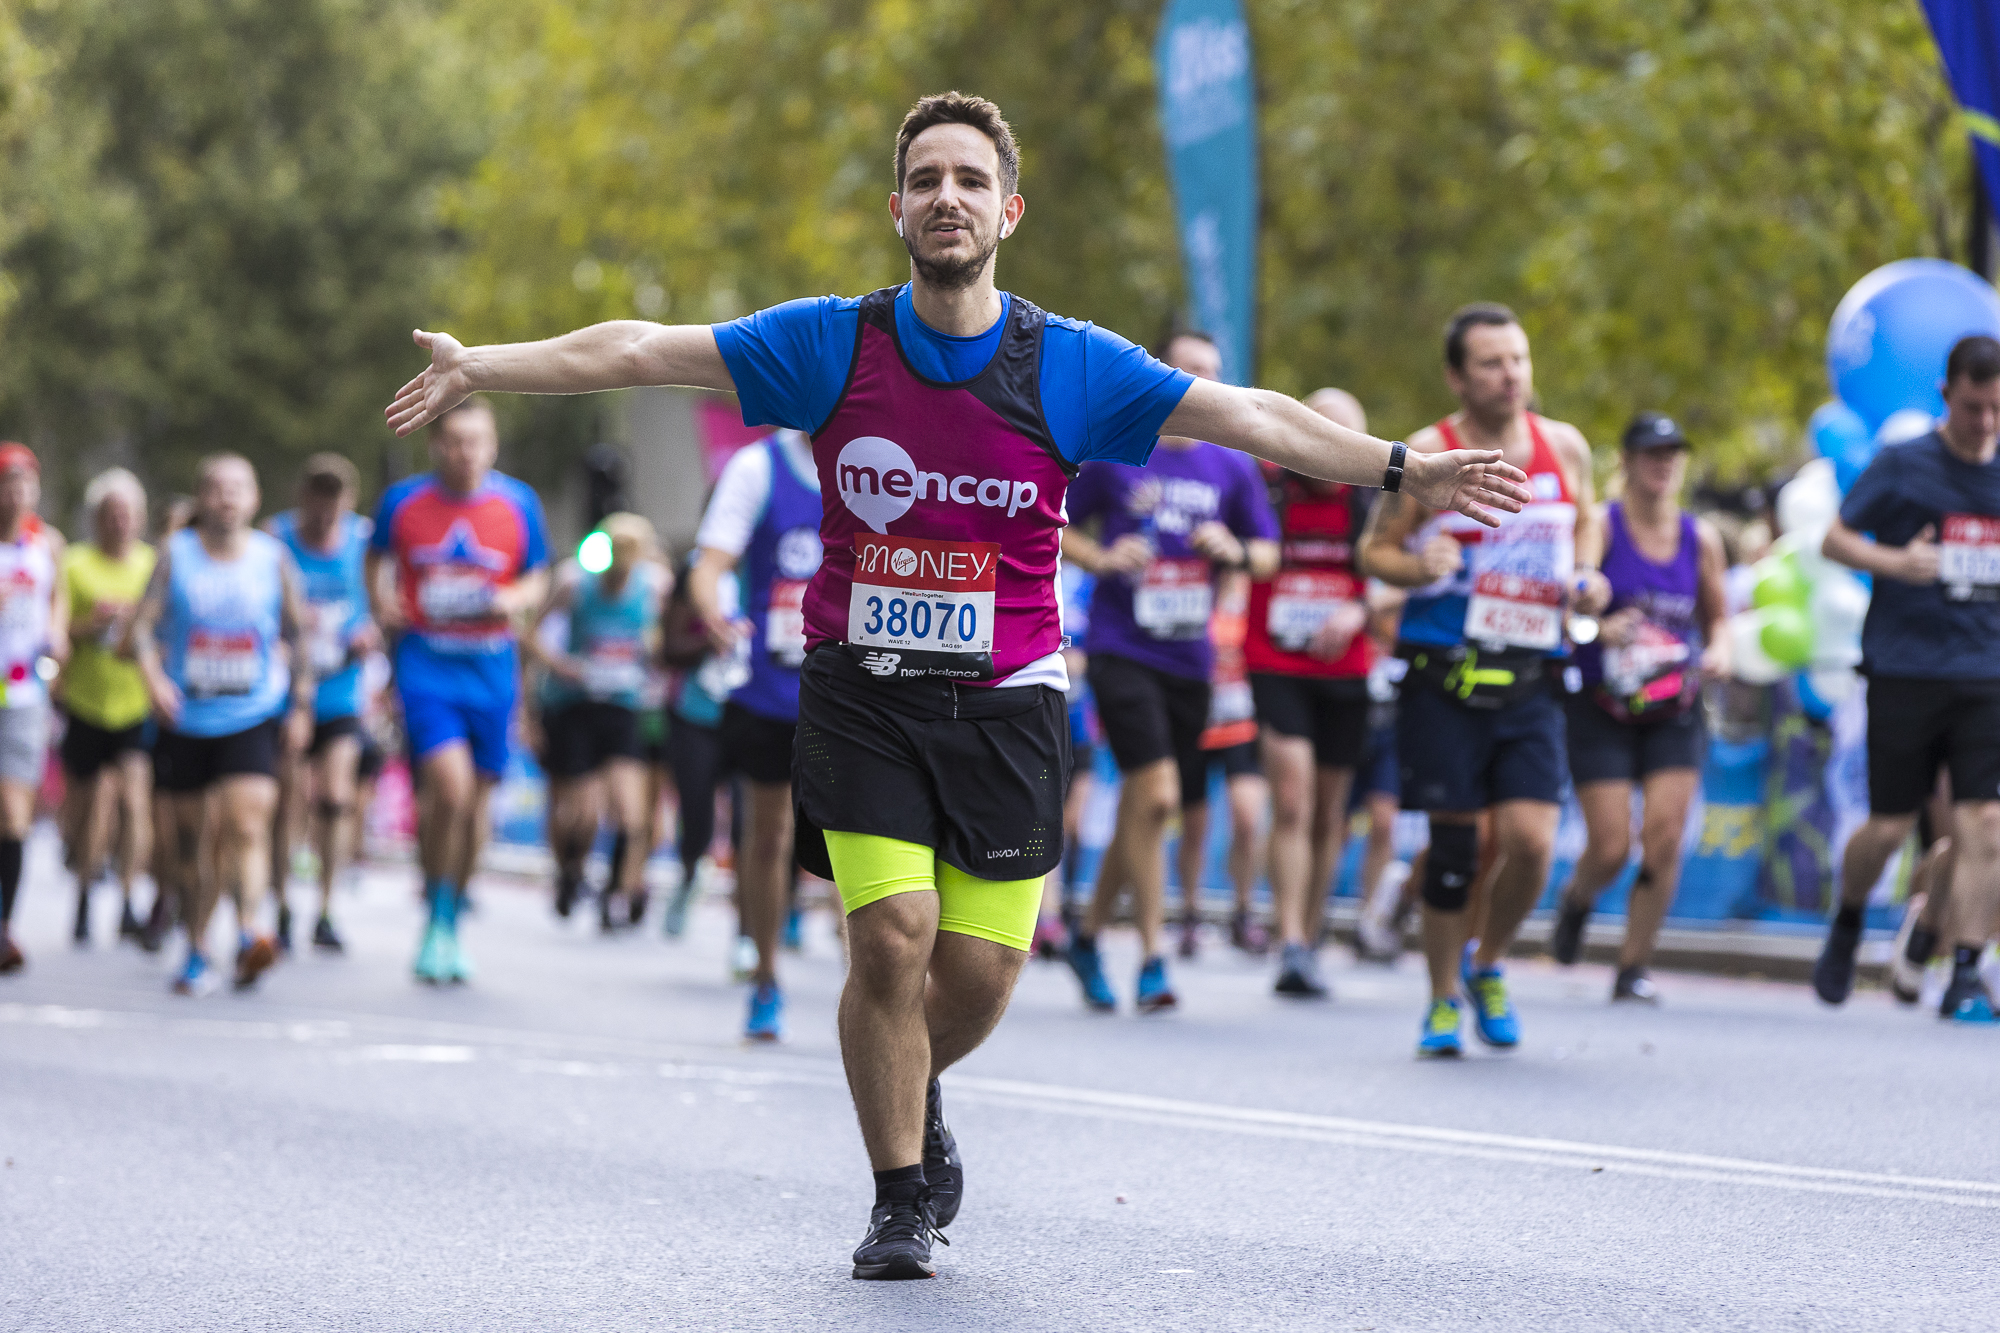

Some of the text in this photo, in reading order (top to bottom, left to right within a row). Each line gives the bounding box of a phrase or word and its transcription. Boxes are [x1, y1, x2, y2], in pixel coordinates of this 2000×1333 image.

[840, 462, 1038, 517] mencap
[861, 543, 991, 581] MONEY
[892, 551, 915, 573] Virgin
[901, 591, 944, 599] #WeRunTogether
[864, 595, 977, 642] 38070
[859, 651, 901, 676] NB
[900, 667, 980, 678] new balance
[987, 848, 1020, 859] LIXADA
